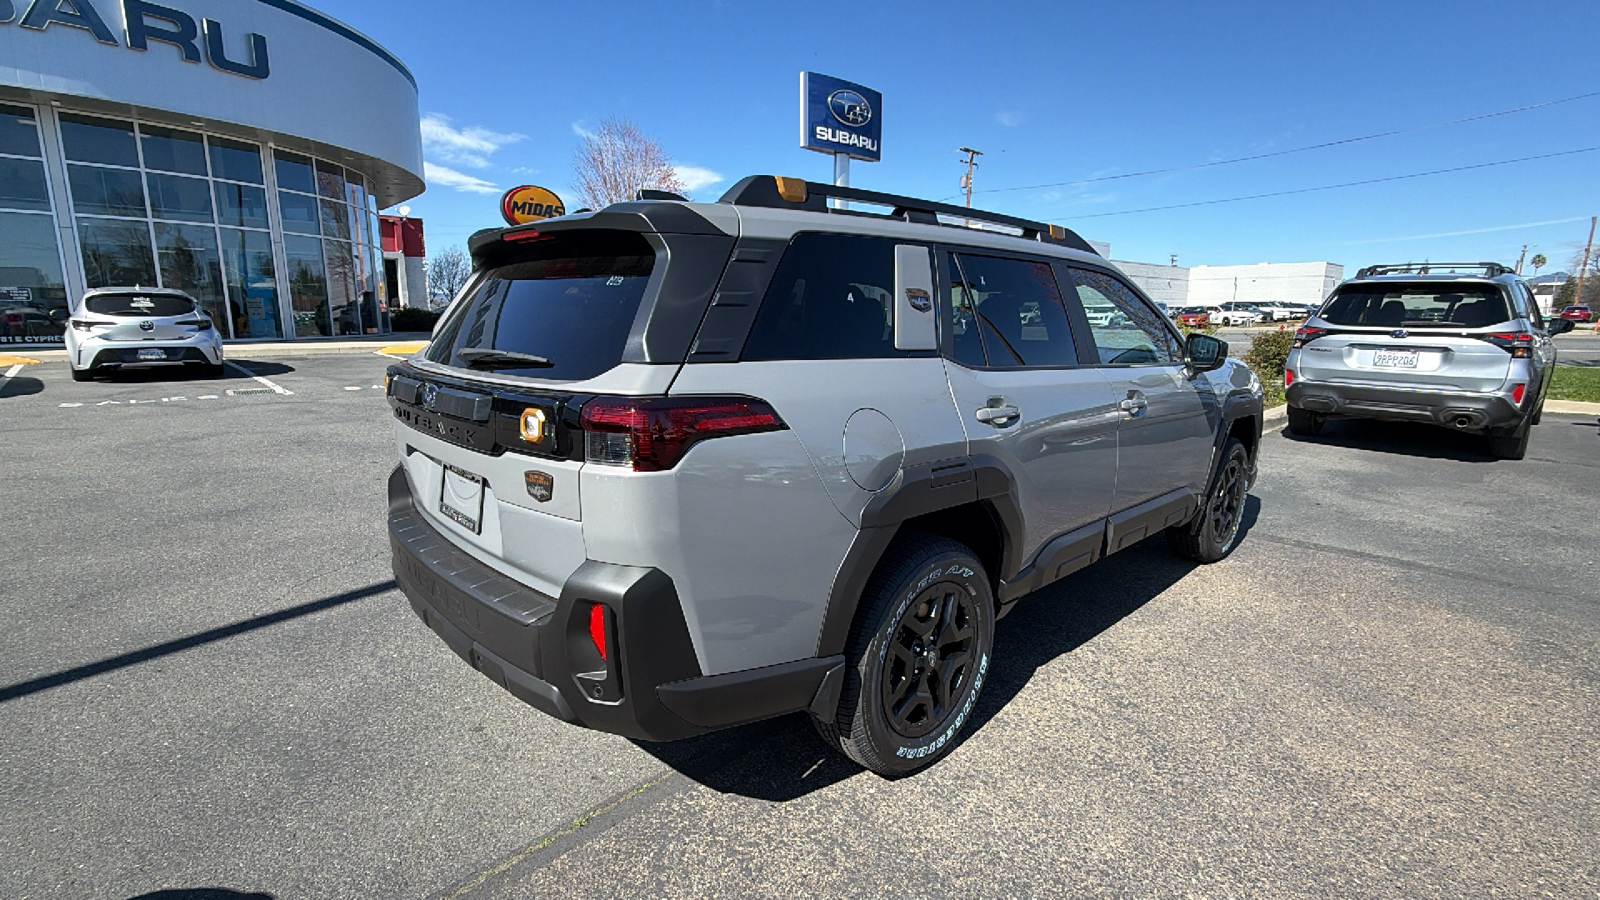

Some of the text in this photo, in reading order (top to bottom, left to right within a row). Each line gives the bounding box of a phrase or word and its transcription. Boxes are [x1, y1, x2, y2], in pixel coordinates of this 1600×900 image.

[0, 0, 270, 80] ARU
[816, 126, 878, 151] SUBARU
[511, 197, 563, 217] MIDAS
[395, 406, 476, 444] OUTBACK
[896, 652, 988, 759] BRIDGESTONE
